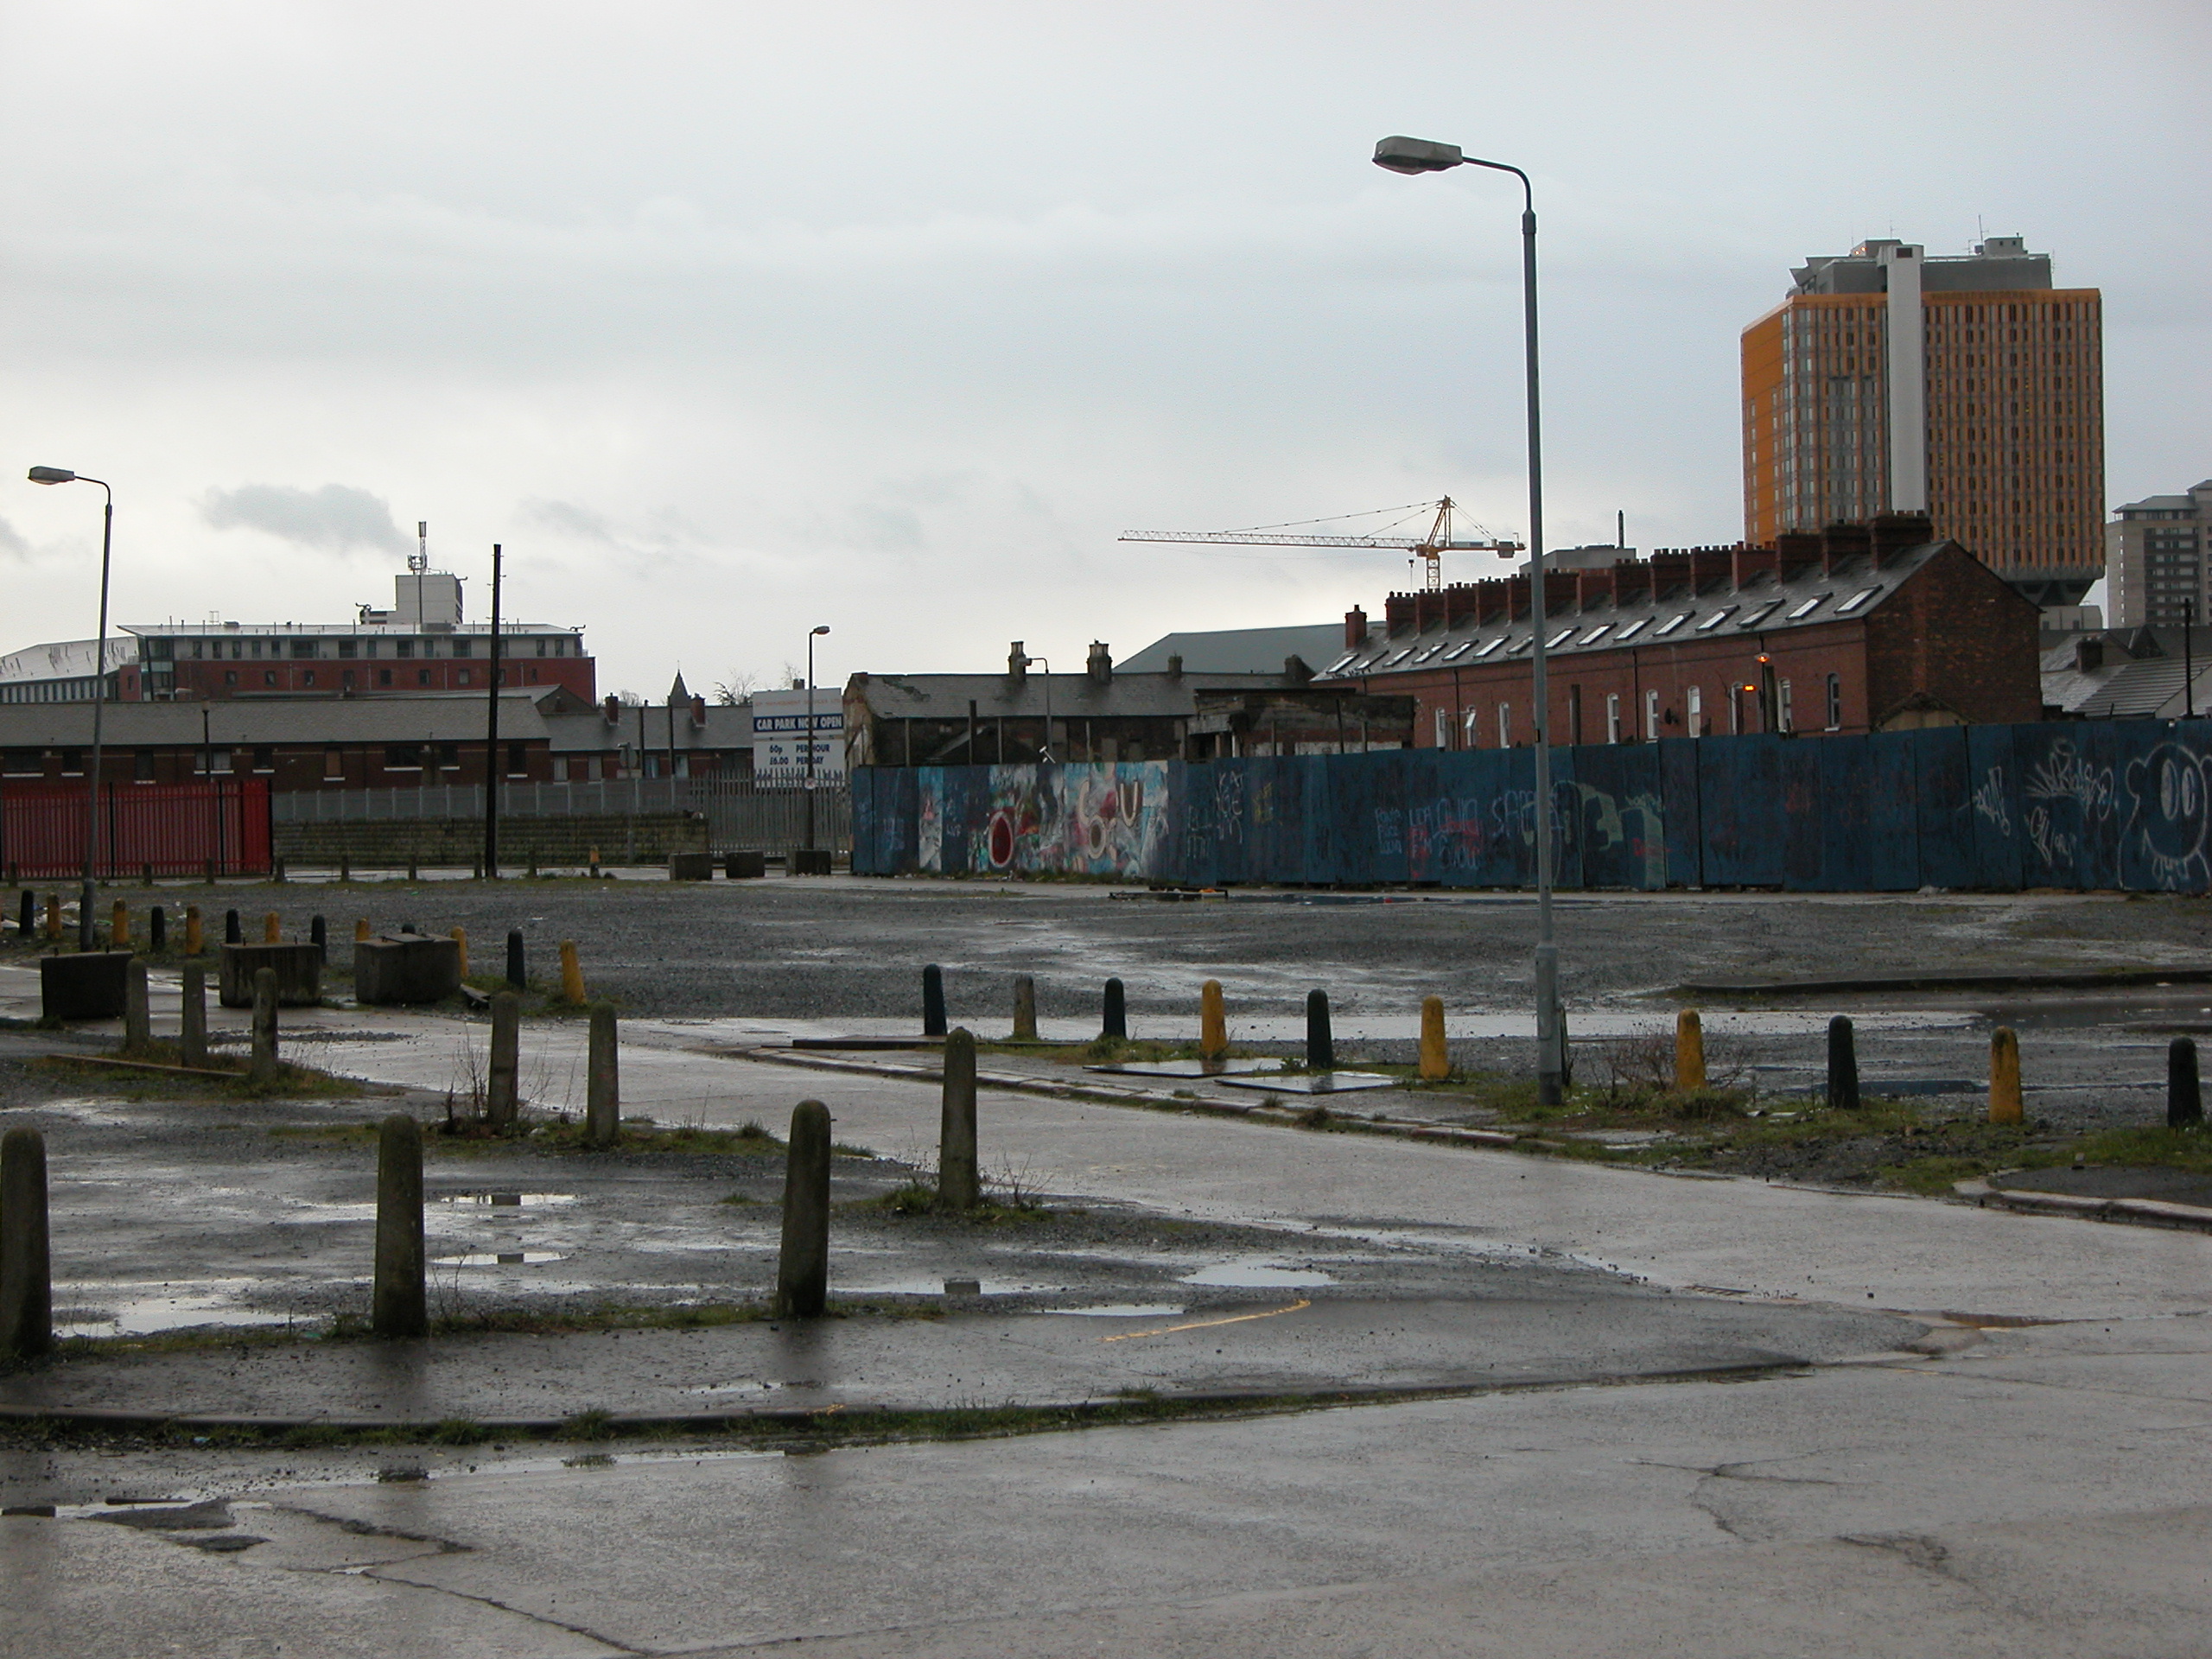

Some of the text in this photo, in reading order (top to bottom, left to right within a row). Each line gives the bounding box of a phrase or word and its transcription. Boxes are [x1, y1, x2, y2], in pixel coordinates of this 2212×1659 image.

[757, 719, 772, 730] CAR
[774, 718, 796, 729] PARK
[820, 715, 842, 728] OPEN
[770, 745, 783, 754] 60p
[796, 744, 810, 753] PER
[770, 756, 789, 765] £6.00
